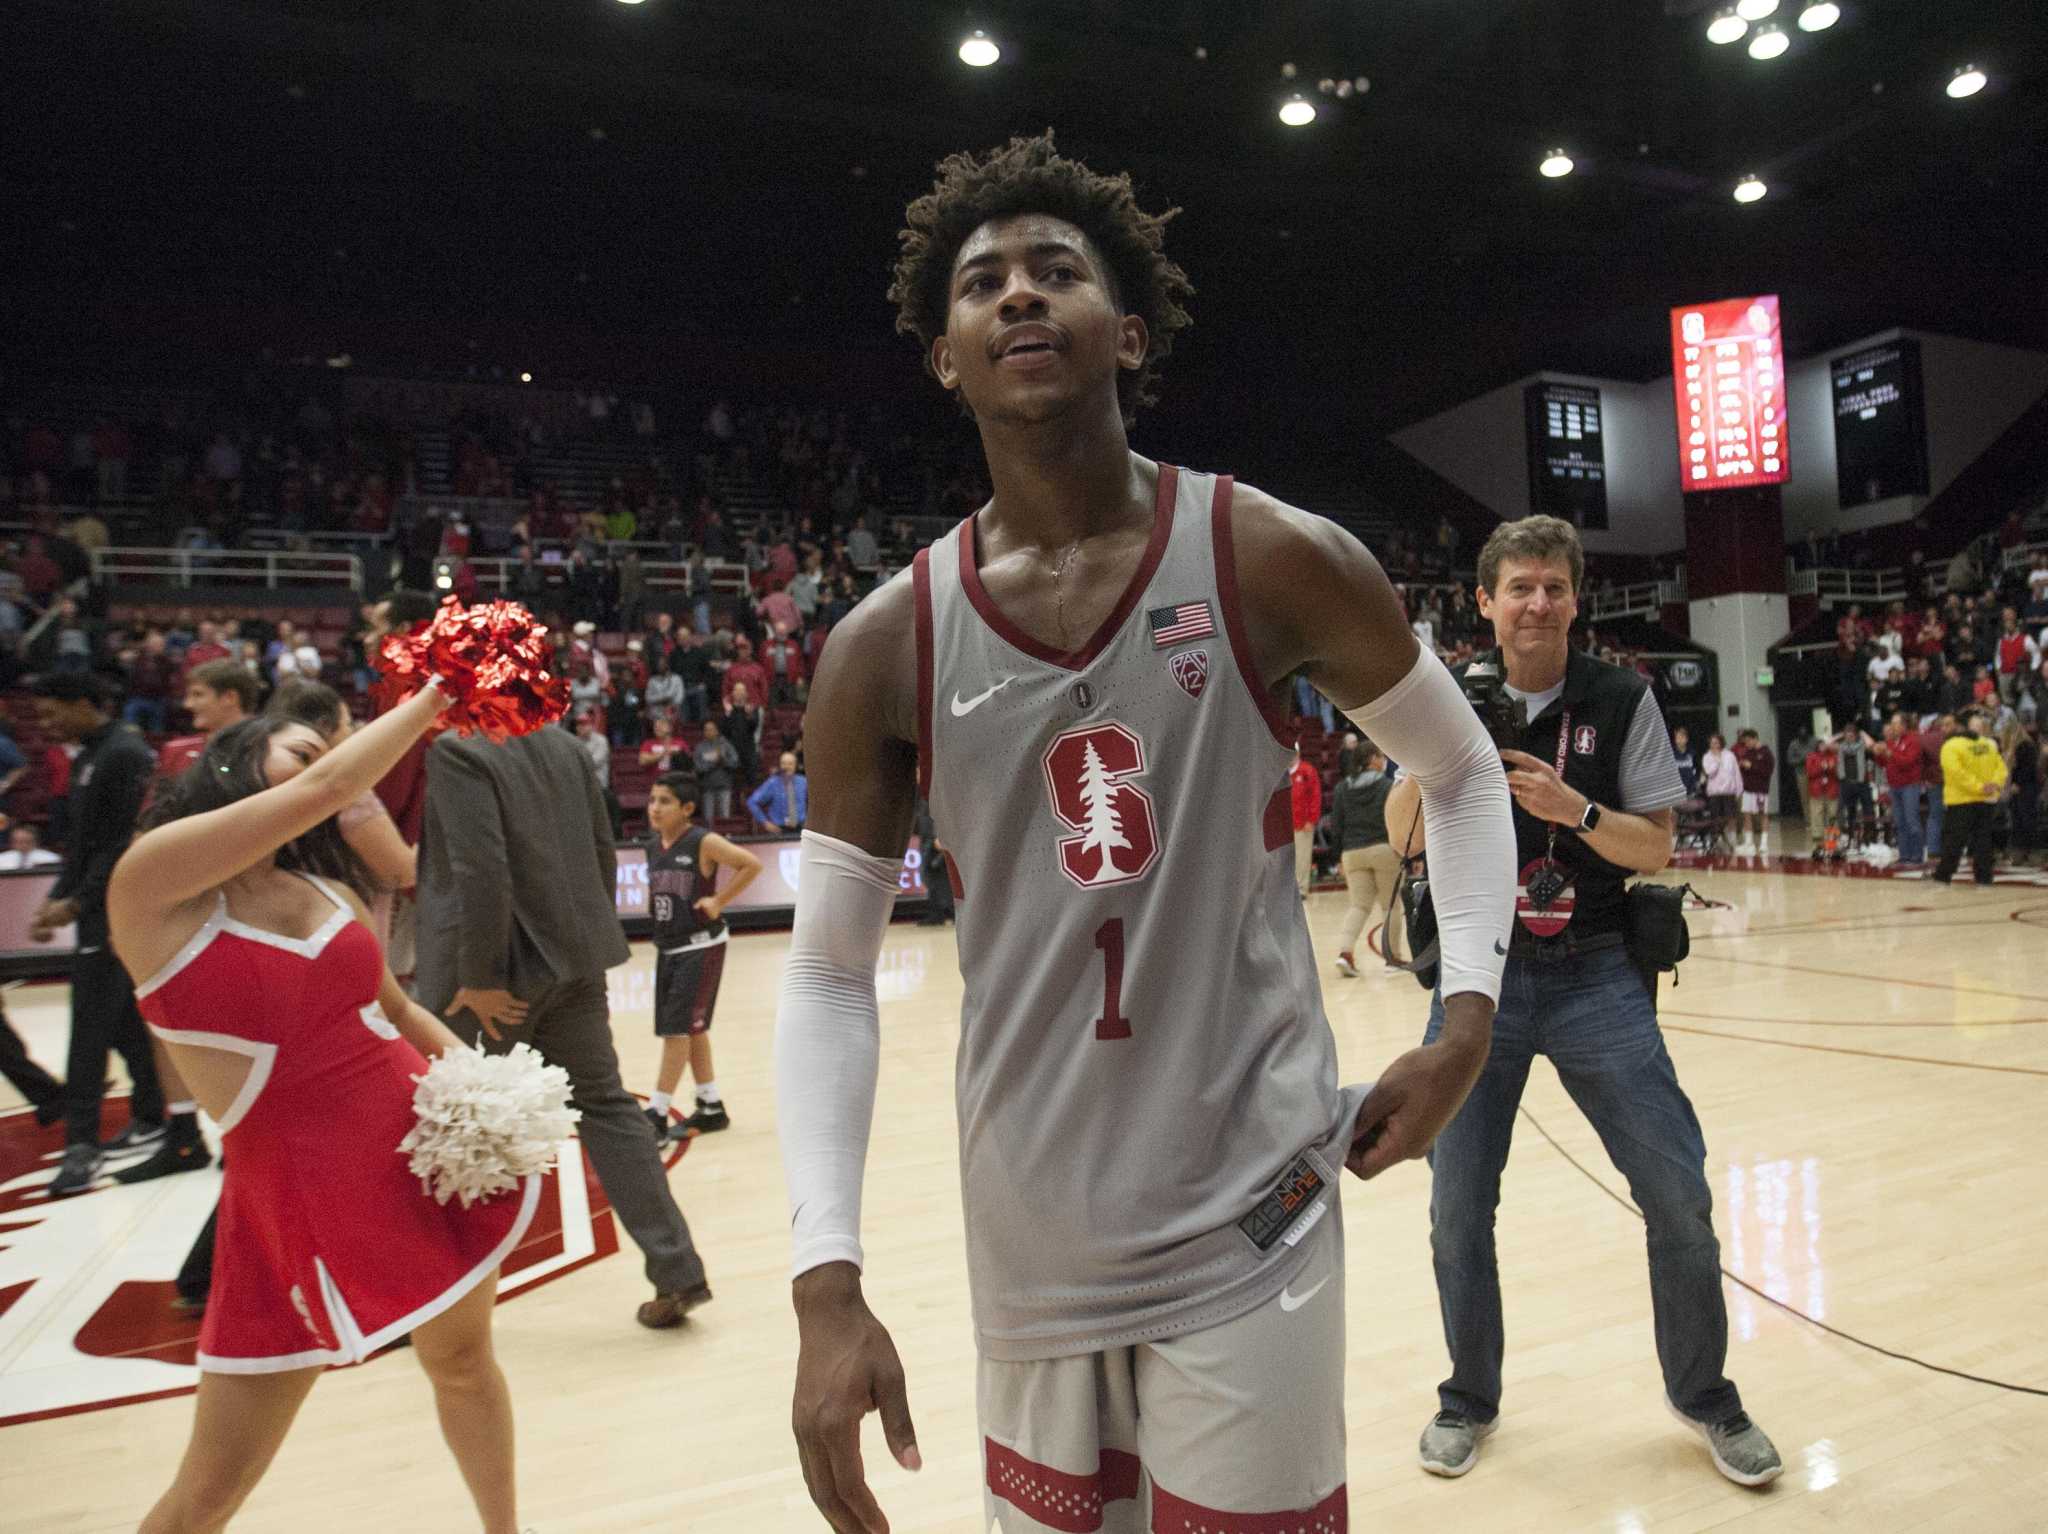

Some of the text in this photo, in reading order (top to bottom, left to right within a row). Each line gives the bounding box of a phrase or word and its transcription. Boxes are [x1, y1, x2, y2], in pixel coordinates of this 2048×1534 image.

[1173, 652, 1206, 681] PAC
[1183, 671, 1202, 690] 12
[1095, 917, 1133, 1041] 1
